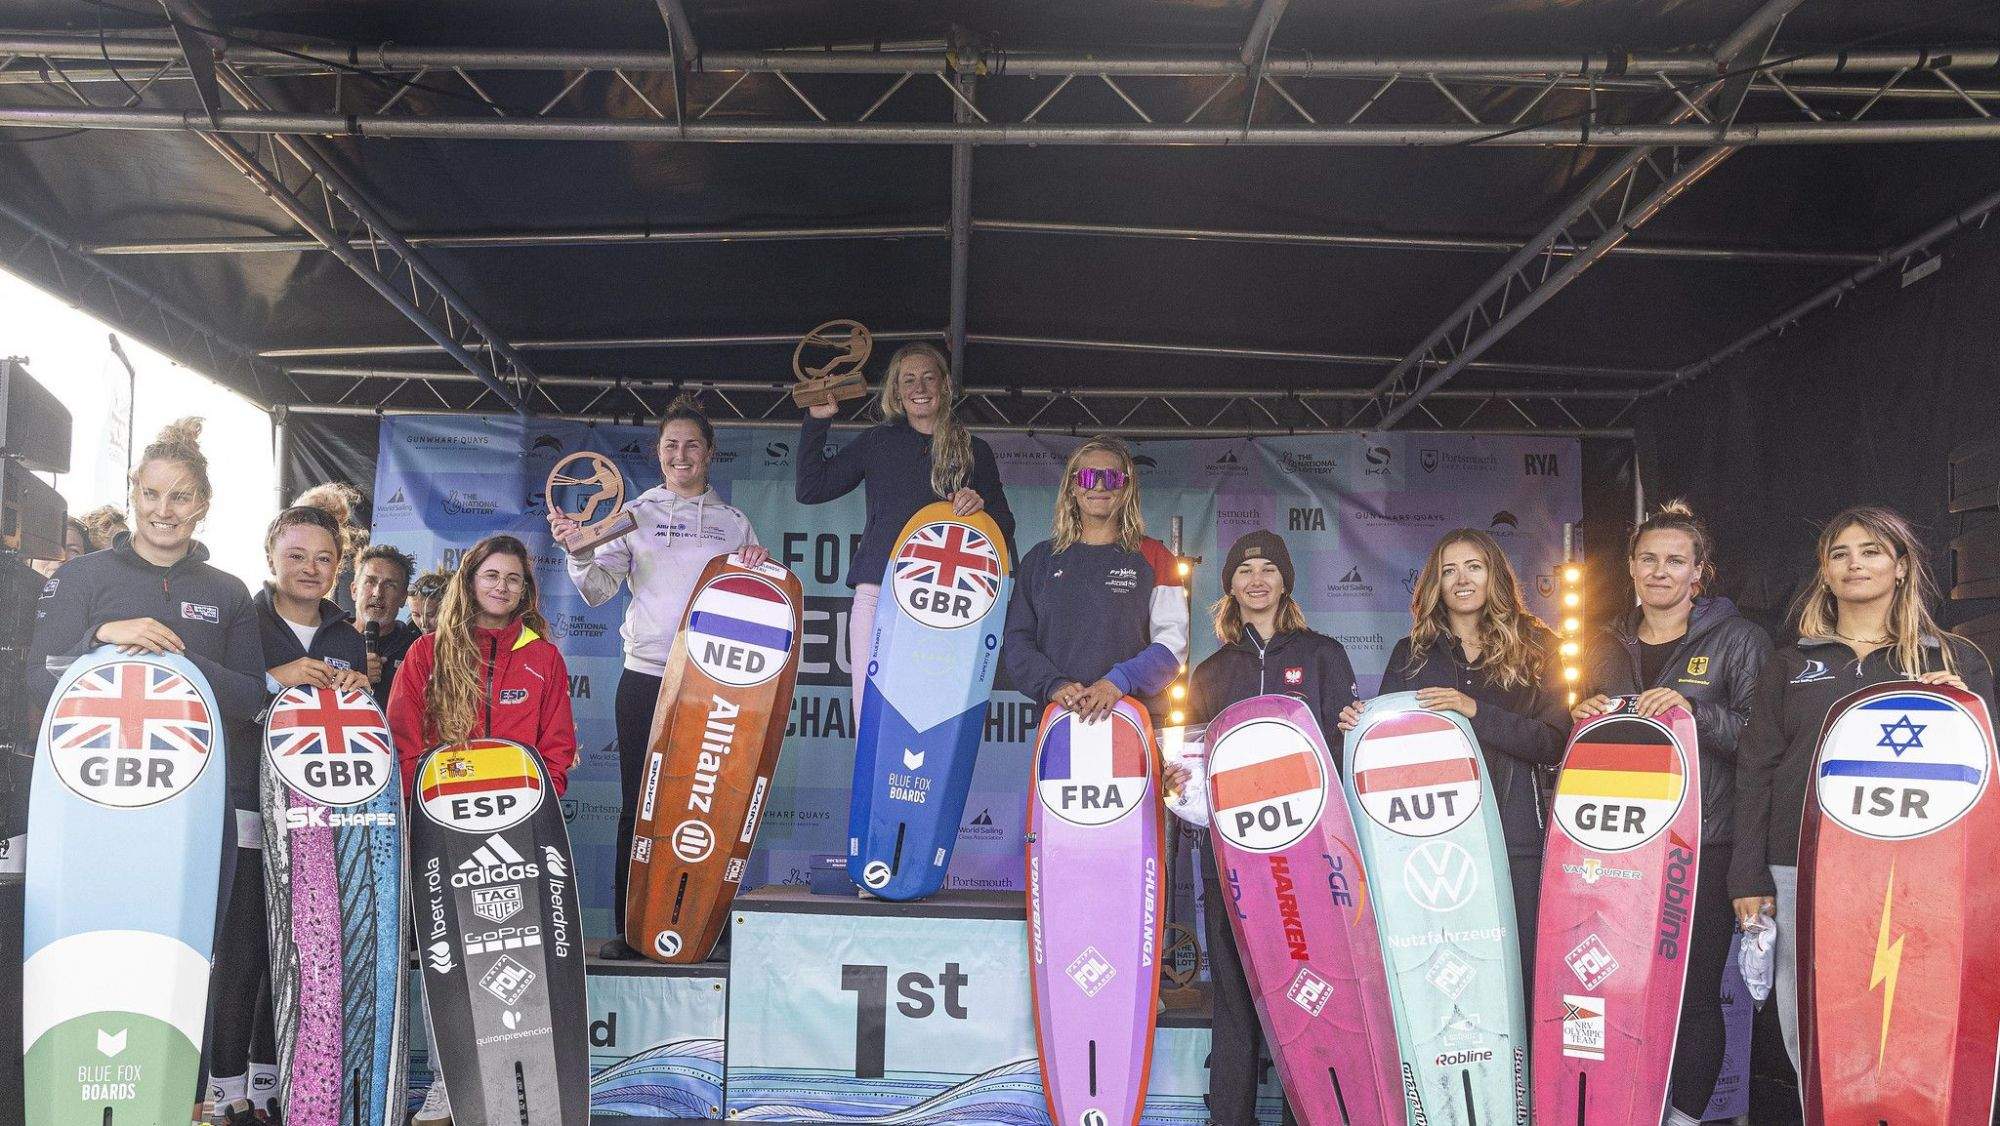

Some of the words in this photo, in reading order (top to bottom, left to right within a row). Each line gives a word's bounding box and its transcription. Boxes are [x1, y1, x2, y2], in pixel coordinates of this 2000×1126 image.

[460, 436, 489, 445] QUAYS
[1365, 468, 1392, 476] IKA
[1524, 453, 1560, 477] RYA
[1217, 509, 1260, 519] tsmouth
[1288, 507, 1326, 531] RYA
[909, 587, 972, 619] GBR
[569, 615, 586, 623] THE
[703, 640, 766, 674] NED
[500, 689, 526, 701] ESP
[568, 674, 591, 699] YA
[589, 752, 610, 761] World
[687, 693, 740, 814] Allianz
[79, 756, 175, 790] GBR
[303, 760, 376, 788] GBR
[888, 772, 912, 790] BLUE
[914, 777, 932, 792] FOX
[889, 785, 927, 804] BOARDS
[1061, 783, 1125, 810] FRA
[1852, 785, 1930, 819] ISR
[286, 806, 329, 829] SK
[329, 812, 396, 828] SHAPES
[451, 794, 518, 821] ESP
[798, 811, 830, 820] QUAYS
[1387, 790, 1459, 824] AUT
[1574, 802, 1647, 836] GER
[958, 826, 980, 834] World
[981, 826, 1003, 835] Sailing
[1234, 802, 1303, 839] POL
[450, 862, 540, 888] adidas
[952, 876, 1013, 888] Portsmouth
[1321, 853, 1353, 907] PGE
[477, 888, 516, 903] TAG
[1658, 848, 1694, 961] Robline
[477, 901, 519, 920] HEUER
[545, 878, 569, 959] Iberdrola
[1031, 856, 1043, 965] CHUBANGA
[1142, 857, 1156, 968] CHUBANGA
[1268, 855, 1311, 961] HARKEN
[464, 925, 540, 944] GoPro
[1073, 957, 1109, 990] FOL
[1572, 946, 1611, 982] FOL
[488, 965, 527, 999] FOL
[1295, 978, 1326, 1010] FOL
[840, 961, 969, 1079] 1st
[1564, 1026, 1601, 1038] OLYMPIC
[1575, 1020, 1593, 1030] NRV
[1571, 1035, 1597, 1046] TEAM
[1436, 1050, 1493, 1067] Robline
[78, 1065, 112, 1083] BLUE
[117, 1064, 142, 1080] FOX
[255, 1077, 274, 1086] SK
[81, 1082, 136, 1101] BOARDS
